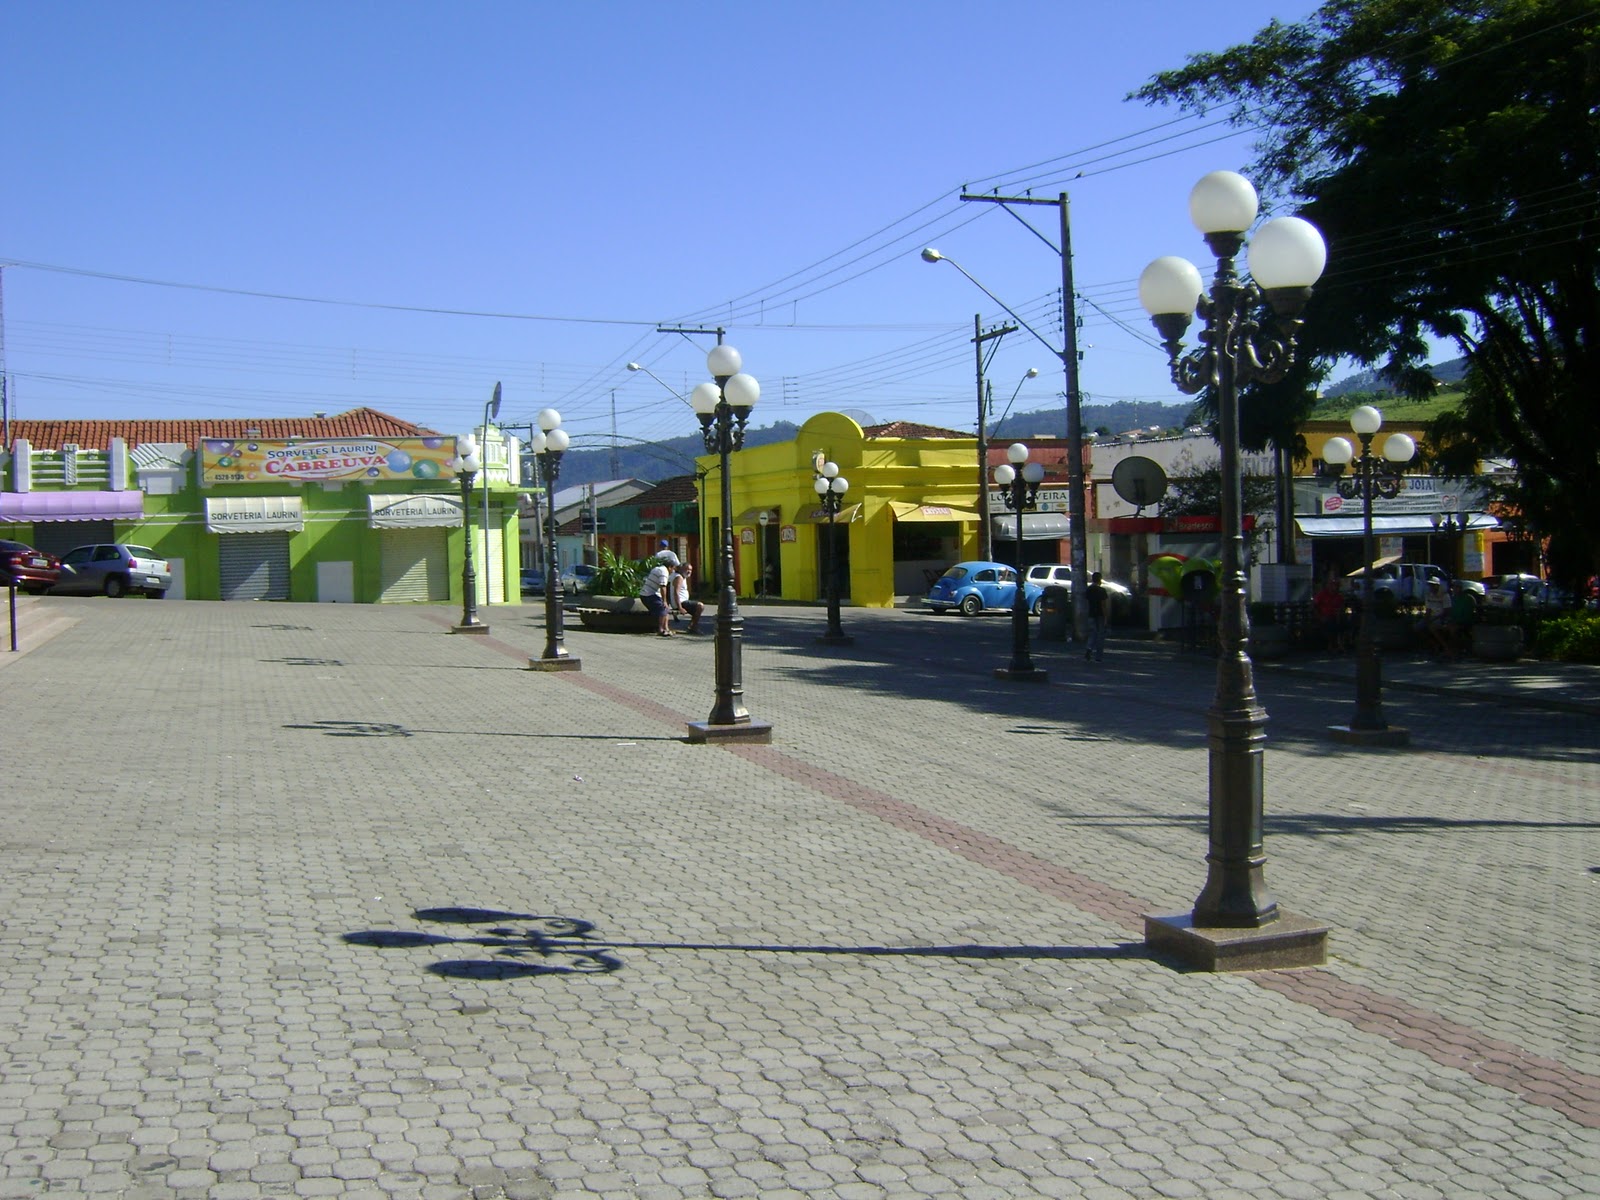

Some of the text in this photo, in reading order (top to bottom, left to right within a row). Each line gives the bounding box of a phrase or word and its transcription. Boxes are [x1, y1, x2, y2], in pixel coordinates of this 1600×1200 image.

[267, 445, 377, 459] SORVETES LAURINI
[1409, 480, 1432, 491] JOIA
[211, 511, 298, 520] SORVETERIA LAURINI
[375, 508, 423, 516] SORVETERIA
